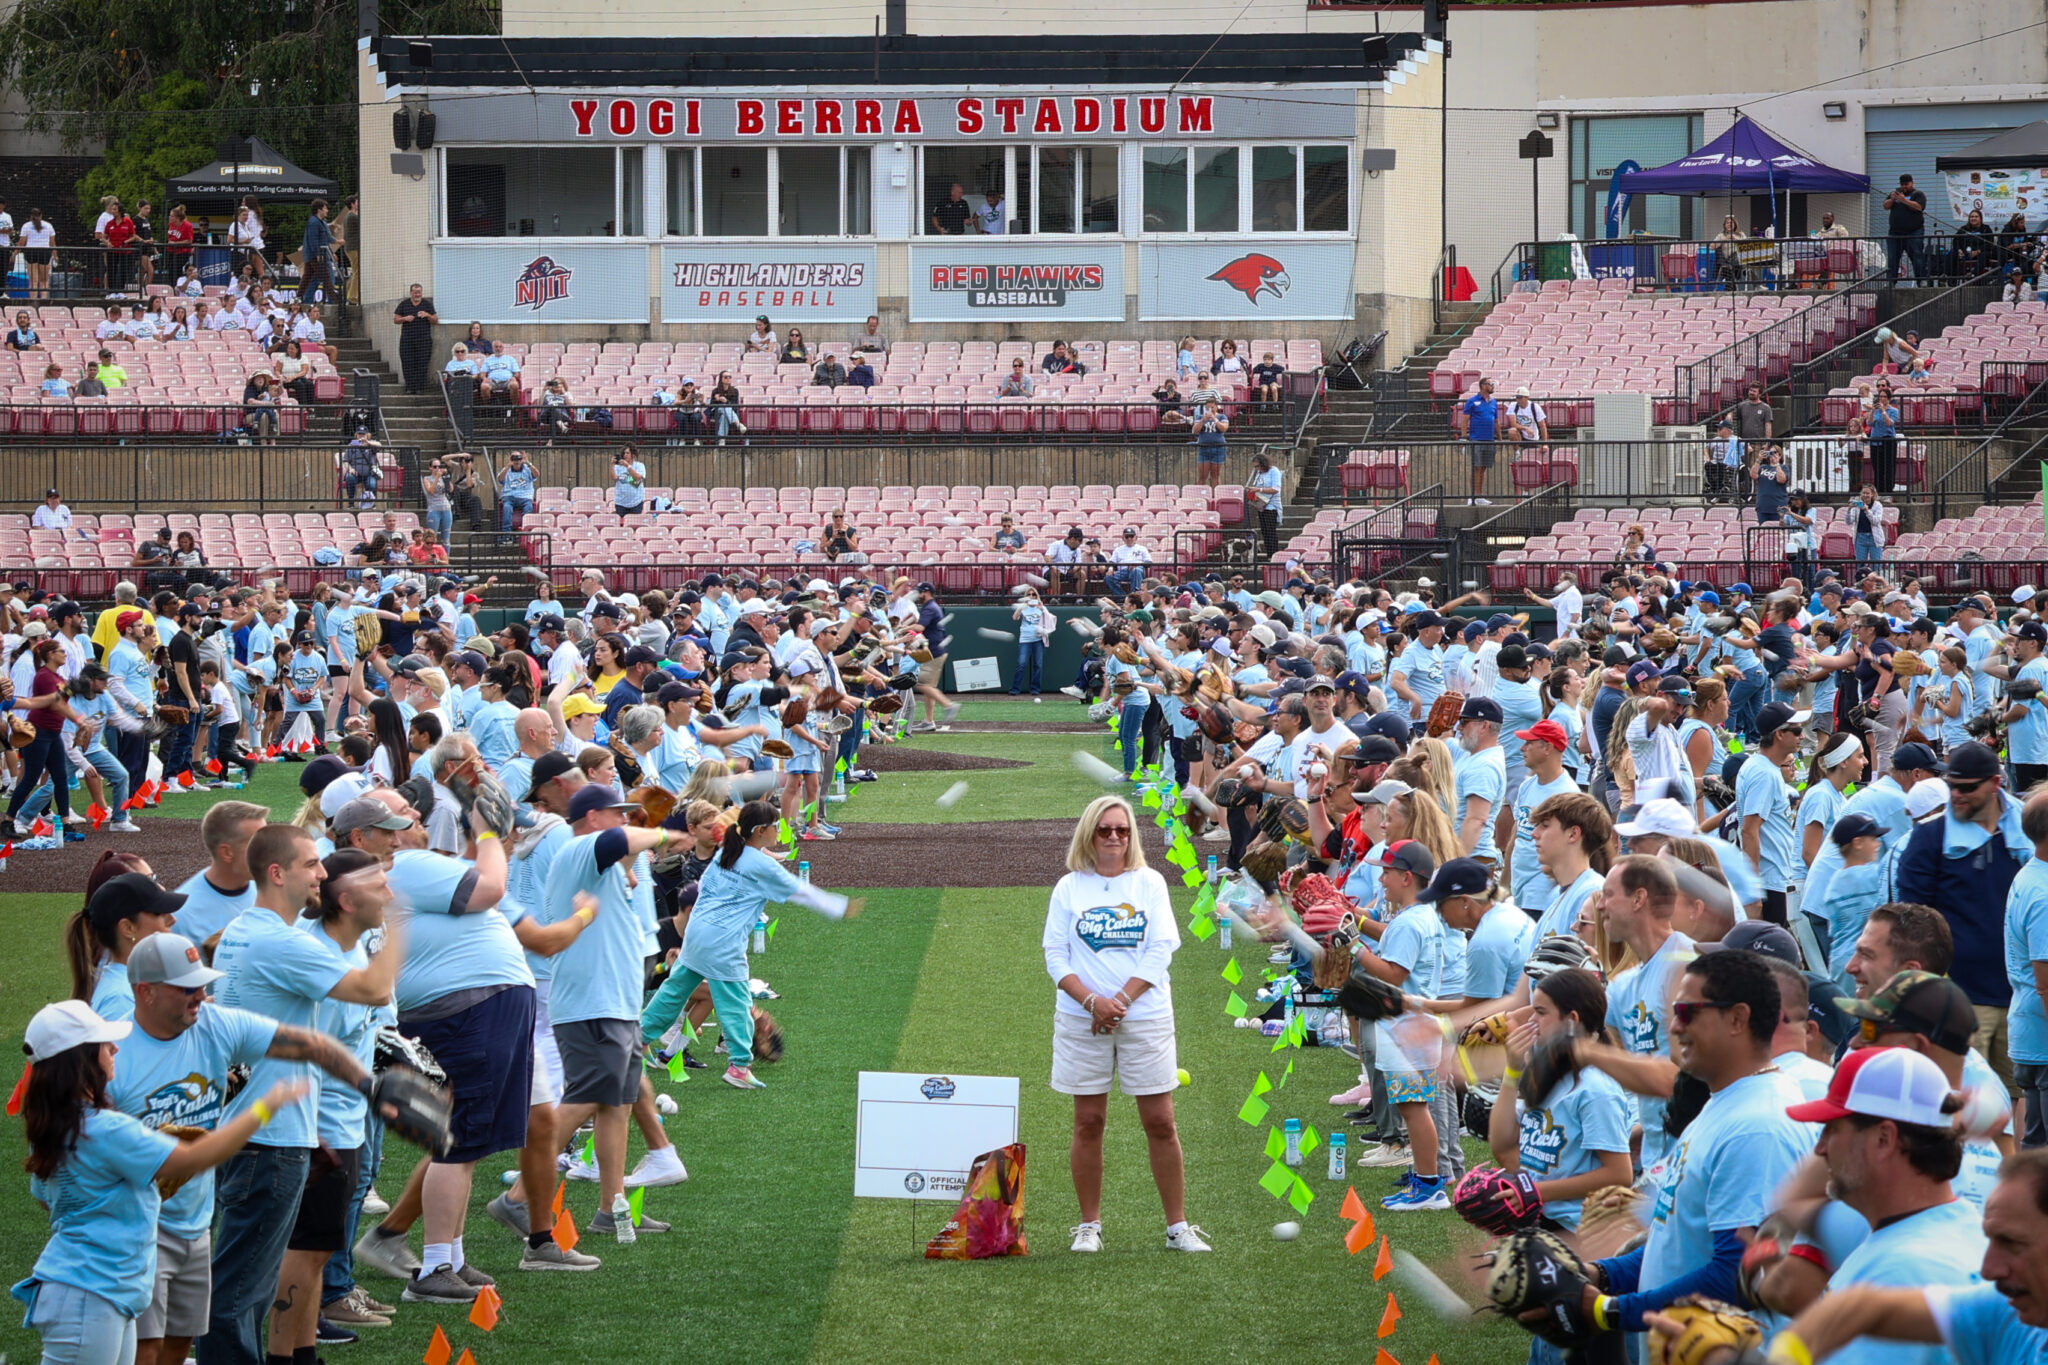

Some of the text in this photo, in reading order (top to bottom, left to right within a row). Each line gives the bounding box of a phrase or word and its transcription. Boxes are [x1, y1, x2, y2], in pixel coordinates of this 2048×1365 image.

[569, 96, 1214, 137] YOGI BERRA STADIUM
[176, 185, 198, 194] Sports
[198, 185, 217, 193] Cards
[252, 185, 276, 195] Trading
[276, 186, 294, 194] Cards
[298, 187, 328, 195] Pokemon
[674, 263, 865, 288] HIGHLANDERS
[930, 265, 1104, 291] RED HAWKS
[514, 270, 572, 310] NJIT
[698, 290, 836, 307] BASEBALL
[975, 292, 1058, 305] BASEBALL
[1079, 913, 1145, 938] Big Catch
[1084, 912, 1110, 922] Yogi's
[1102, 931, 1143, 939] CHALLENGE
[148, 1092, 180, 1110] Yogi's
[174, 1085, 219, 1118] Catch
[1334, 1147, 1344, 1175] care
[930, 1176, 966, 1185] OFFICIAL
[930, 1184, 966, 1192] ATTEMPT
